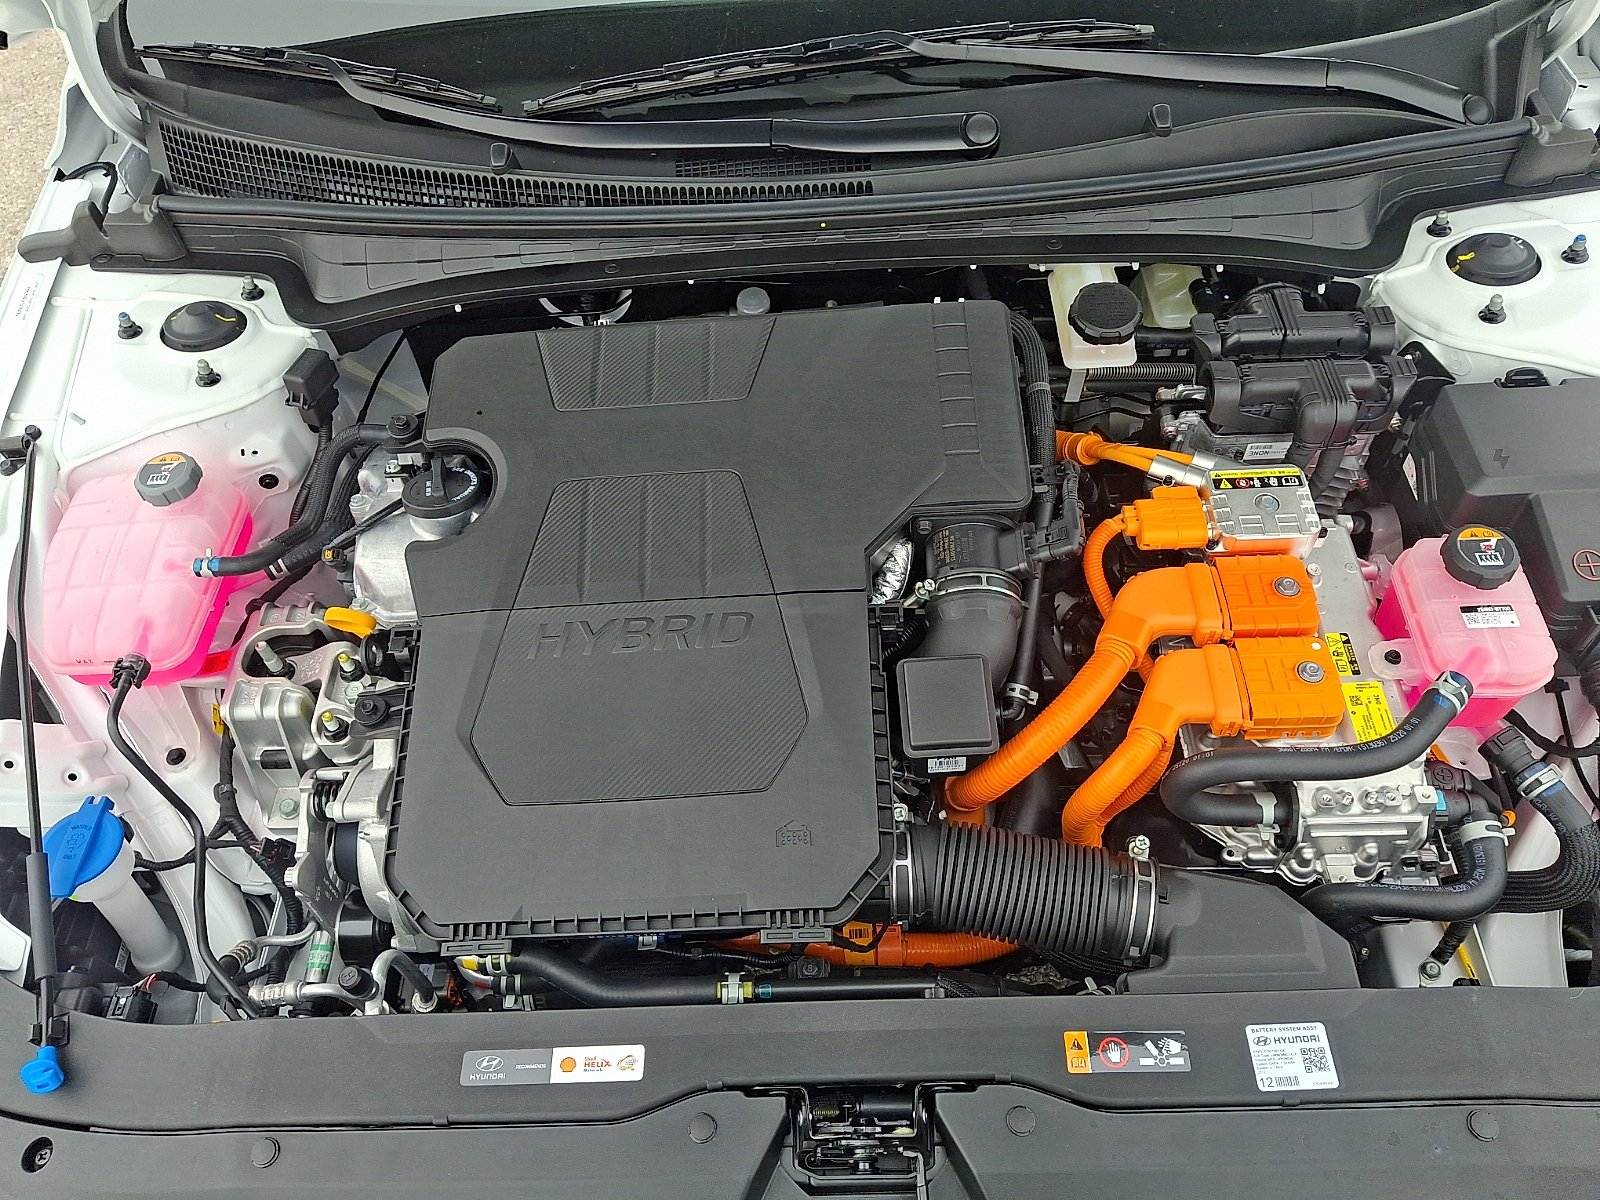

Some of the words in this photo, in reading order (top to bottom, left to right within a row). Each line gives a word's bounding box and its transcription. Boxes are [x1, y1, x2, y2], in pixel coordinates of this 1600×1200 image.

[527, 611, 754, 659] HYBRID
[1274, 1034, 1320, 1044] HYUNDAI
[584, 1060, 612, 1068] HELIX
[1260, 1077, 1274, 1088] 12
